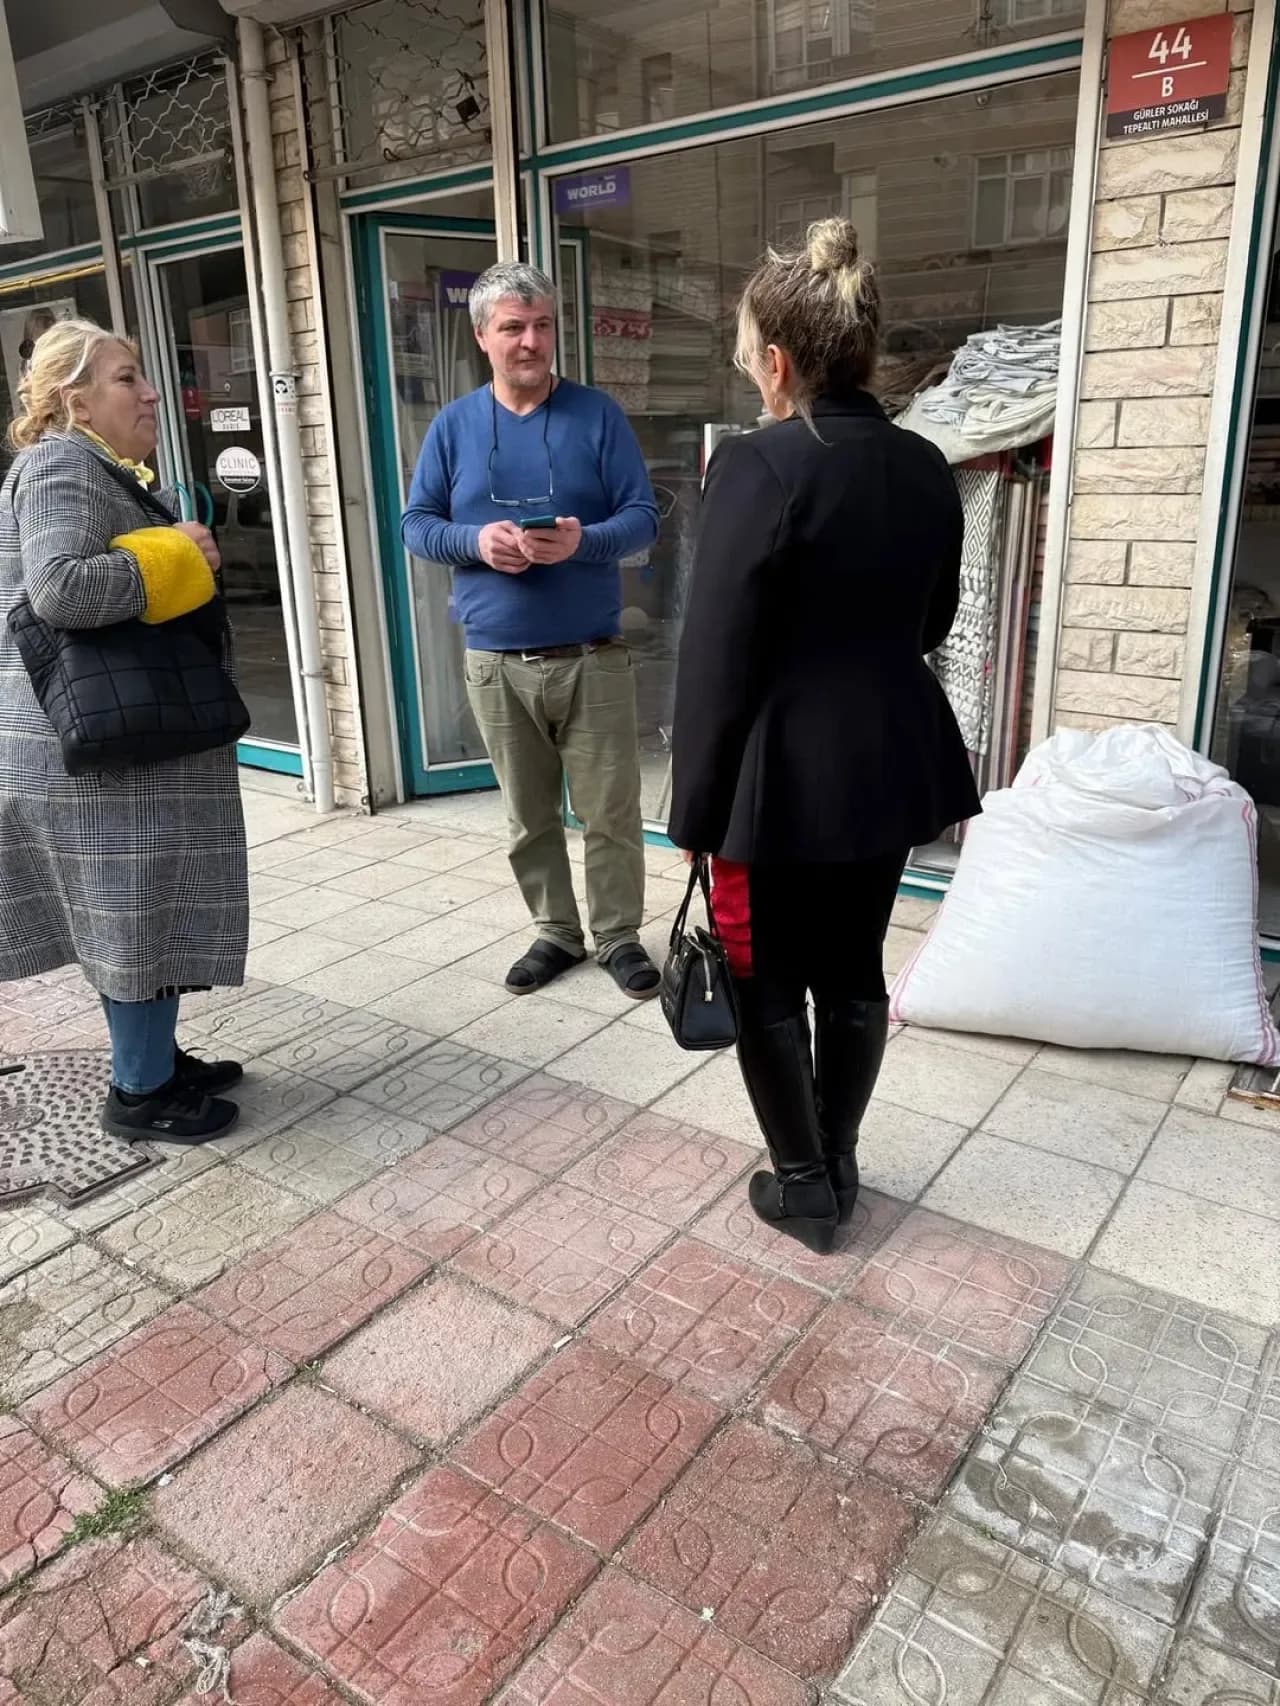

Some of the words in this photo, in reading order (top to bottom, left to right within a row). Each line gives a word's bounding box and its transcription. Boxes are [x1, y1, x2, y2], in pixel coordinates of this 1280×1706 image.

[1148, 27, 1193, 64] 44
[1161, 76, 1174, 97] B
[1133, 106, 1165, 121] GÜRLER
[1167, 99, 1199, 115] SOKAĞI
[1123, 120, 1160, 135] TEPEALTI
[1161, 109, 1209, 128] MAHALLESİ
[567, 181, 617, 201] WORLD
[220, 456, 256, 470] CLINIC
